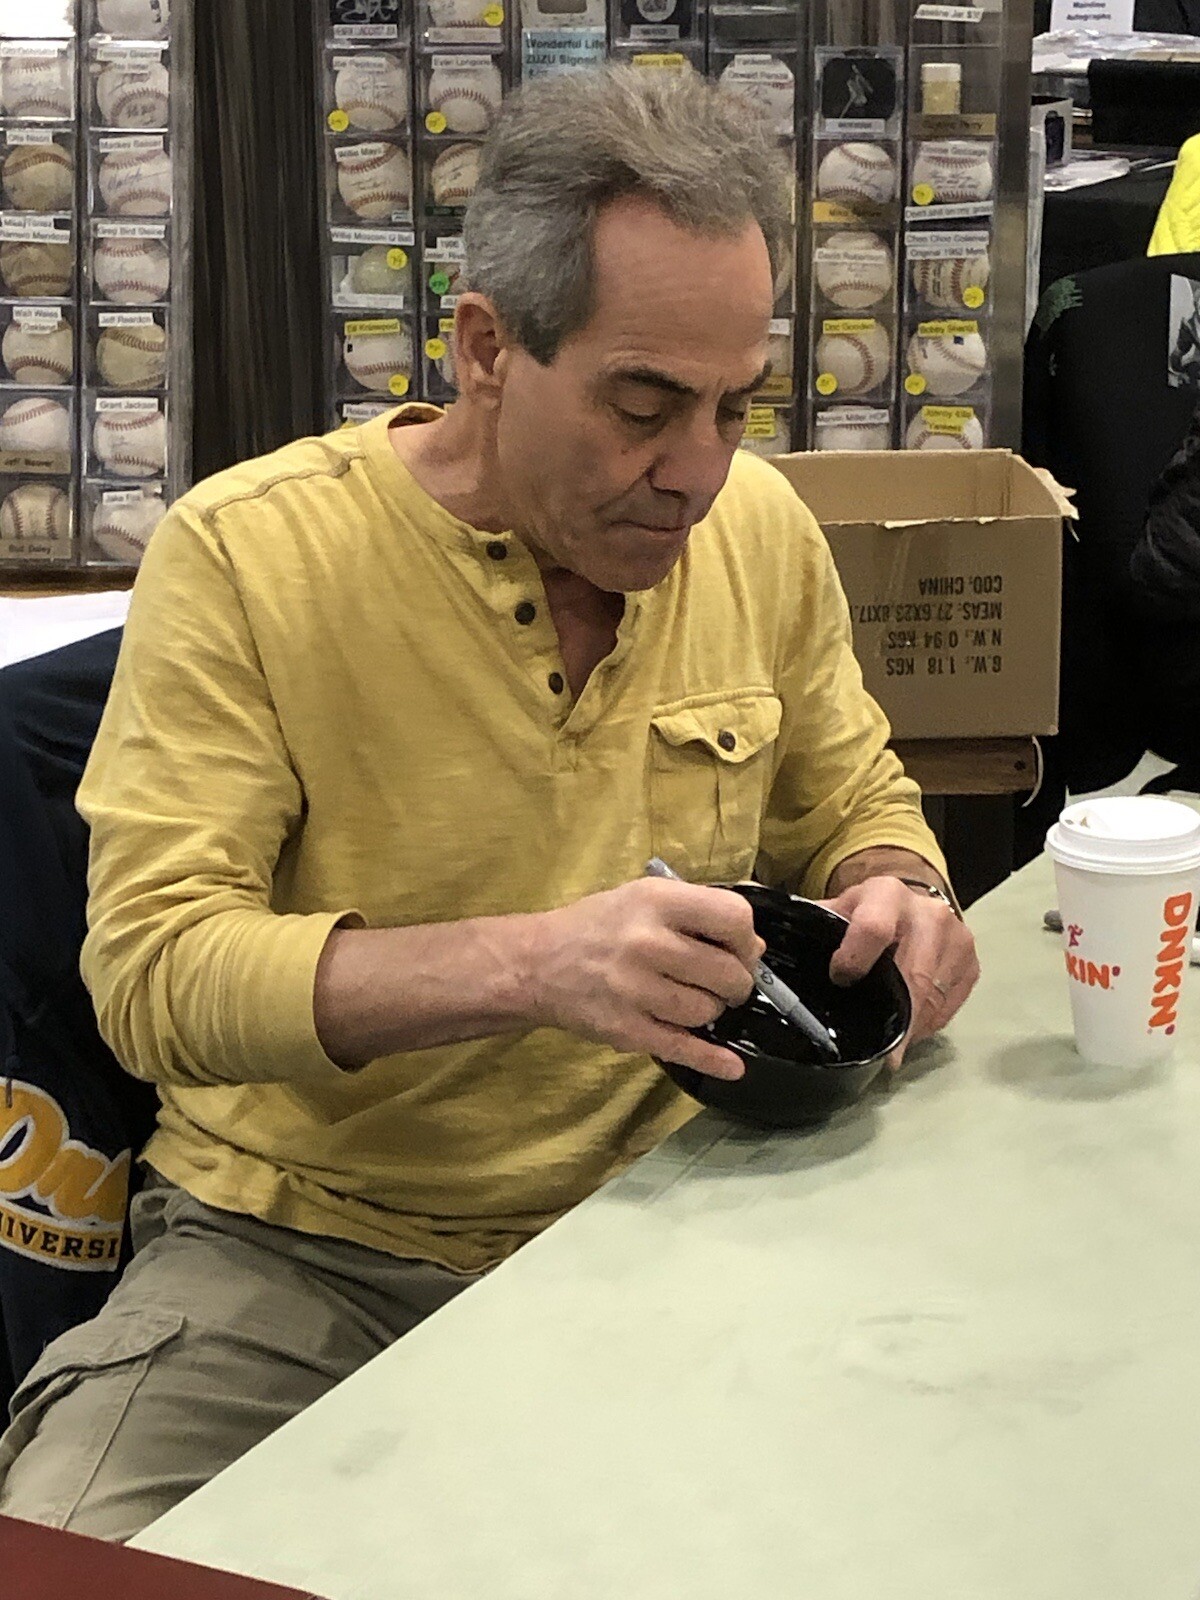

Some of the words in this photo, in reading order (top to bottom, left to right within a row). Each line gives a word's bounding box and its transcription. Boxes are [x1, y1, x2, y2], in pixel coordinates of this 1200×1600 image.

[526, 39, 582, 49] Wonderful
[526, 54, 556, 64] ZUZU
[559, 55, 597, 66] Signed
[101, 401, 124, 410] Grant
[125, 401, 158, 410] Jackson
[919, 576, 965, 596] CHINA
[888, 630, 916, 650] KGS
[886, 657, 915, 676] KGS
[0, 1207, 119, 1259] IVERSI
